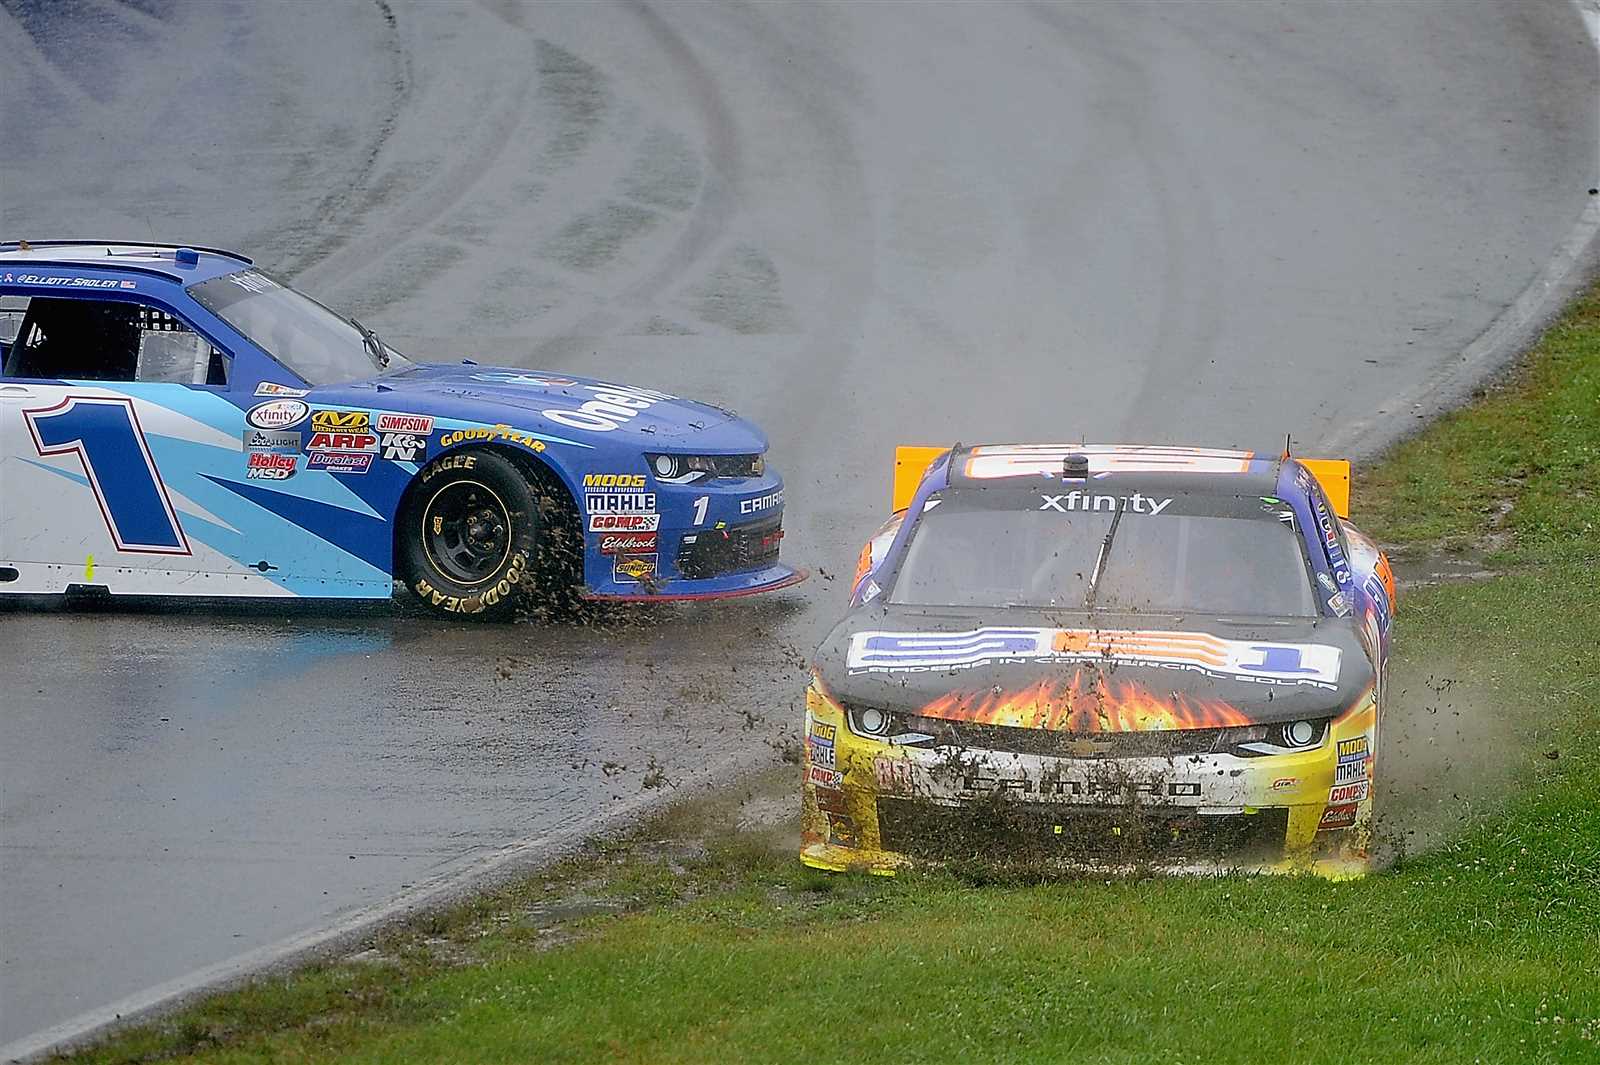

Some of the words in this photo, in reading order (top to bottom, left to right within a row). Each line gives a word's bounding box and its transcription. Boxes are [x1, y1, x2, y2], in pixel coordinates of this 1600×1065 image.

[256, 408, 297, 422] xfinity
[380, 416, 430, 432] SIMPSON
[309, 434, 377, 449] ARP
[250, 452, 297, 470] Holley
[312, 454, 367, 466] Duralast
[22, 395, 192, 556] 1
[247, 468, 288, 480] MSD
[583, 474, 647, 487] MOOG
[587, 494, 655, 511] MAHLE
[740, 489, 785, 514] CAMAR
[1040, 492, 1173, 516] xfinity
[693, 496, 710, 526] 1
[592, 516, 643, 529] COMP
[602, 536, 656, 549] Edelbrock
[617, 563, 655, 573] SUNOCO
[415, 553, 526, 614] GOODEAR
[1336, 760, 1366, 781] MAHLE
